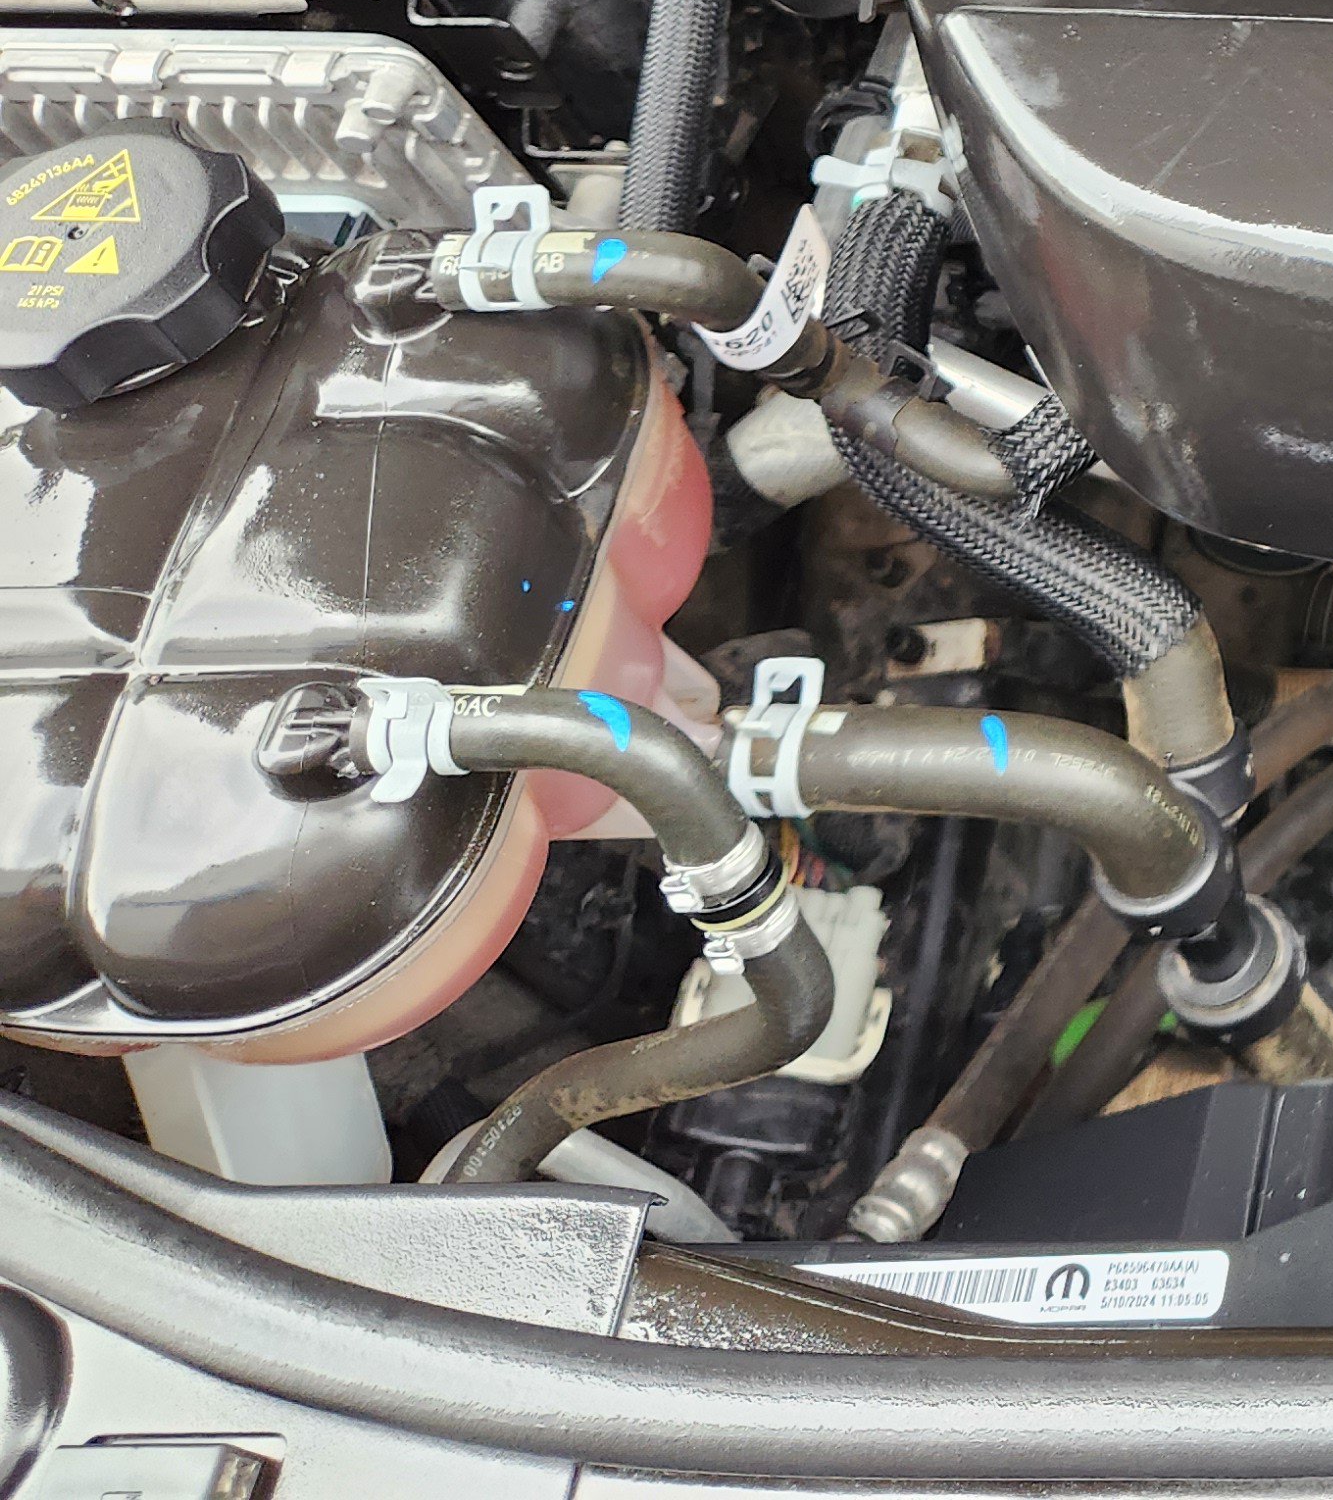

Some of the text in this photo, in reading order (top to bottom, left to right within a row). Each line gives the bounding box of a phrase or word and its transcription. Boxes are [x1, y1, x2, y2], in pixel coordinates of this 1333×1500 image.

[6, 154, 95, 206] 68249136AA
[27, 285, 65, 296] 21 PSI
[36, 297, 60, 309] kPa
[1039, 1304, 1087, 1313] MOPAR
